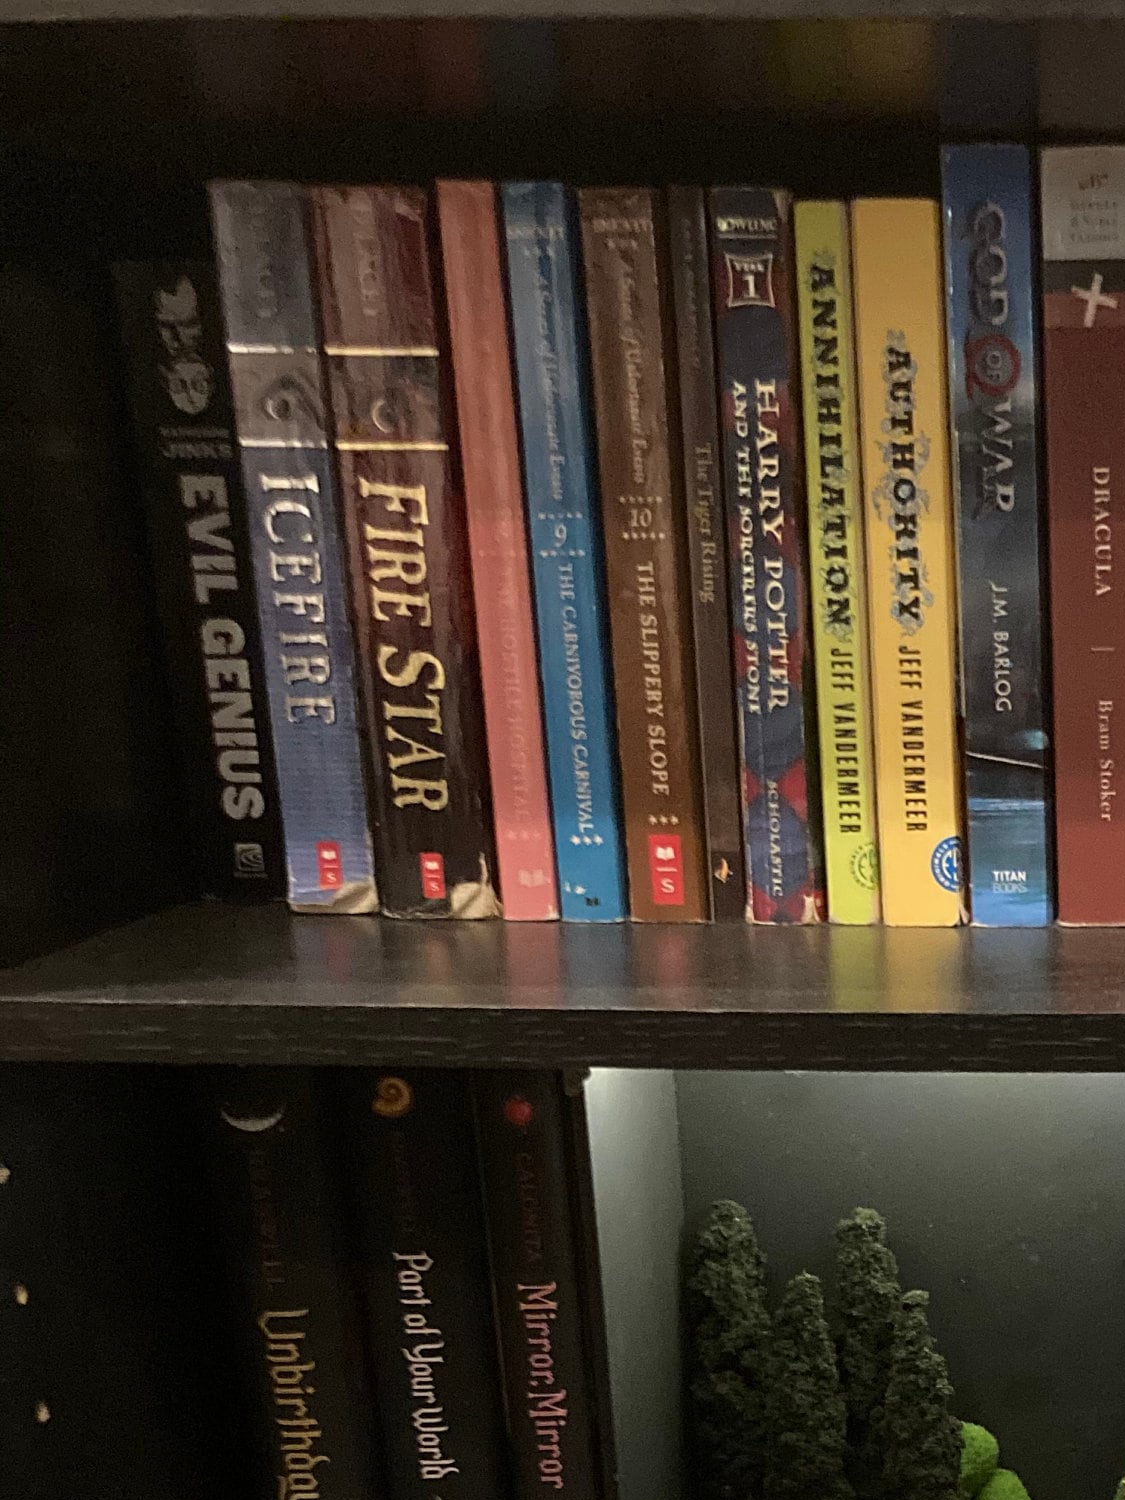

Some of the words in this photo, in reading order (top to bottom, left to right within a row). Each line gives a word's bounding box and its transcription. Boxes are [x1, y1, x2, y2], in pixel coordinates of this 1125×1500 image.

[744, 275, 760, 298] 1
[733, 382, 748, 437] AND
[810, 262, 851, 627] ANNIHILATION
[696, 442, 713, 478] The
[736, 448, 753, 497] THE
[755, 379, 785, 544] HARRY
[886, 347, 922, 620] AUTHORITY
[179, 474, 238, 605] EVIL
[554, 524, 567, 547] 9
[629, 508, 652, 529] 10
[695, 484, 714, 538] Tiger
[1092, 466, 1112, 597] DRACULA
[358, 476, 434, 629] FIRE
[557, 563, 576, 601] THE
[636, 561, 655, 608] THE
[698, 539, 718, 603] Rising
[260, 473, 337, 727] ICEFIRE
[763, 556, 790, 713] POTTER
[989, 580, 1008, 622] J.M.
[562, 604, 588, 742] CARNIVOROUS
[639, 614, 664, 719] SLIPPERY
[746, 639, 762, 714] STONE
[831, 648, 853, 692] JEFF
[898, 645, 922, 689] JEFF
[993, 630, 1012, 712] BARLOG
[203, 615, 266, 822] GENIUS
[375, 642, 450, 814] STAR
[1098, 700, 1113, 751] Bram
[571, 744, 594, 834] CARNIVAL
[647, 724, 670, 797] SLOPE
[833, 702, 861, 834] VANDERMEER
[901, 700, 927, 831] VANDERMEER
[1099, 758, 1117, 822] Stoker
[766, 779, 783, 897] SCHOLASTIC
[992, 871, 1027, 883] TITAN
[992, 882, 1027, 894] BOOKS
[392, 1251, 434, 1304] Part
[404, 1312, 442, 1335] of
[402, 1340, 444, 1406] Your
[411, 1407, 460, 1480] World
[529, 1388, 568, 1489] Mirror
